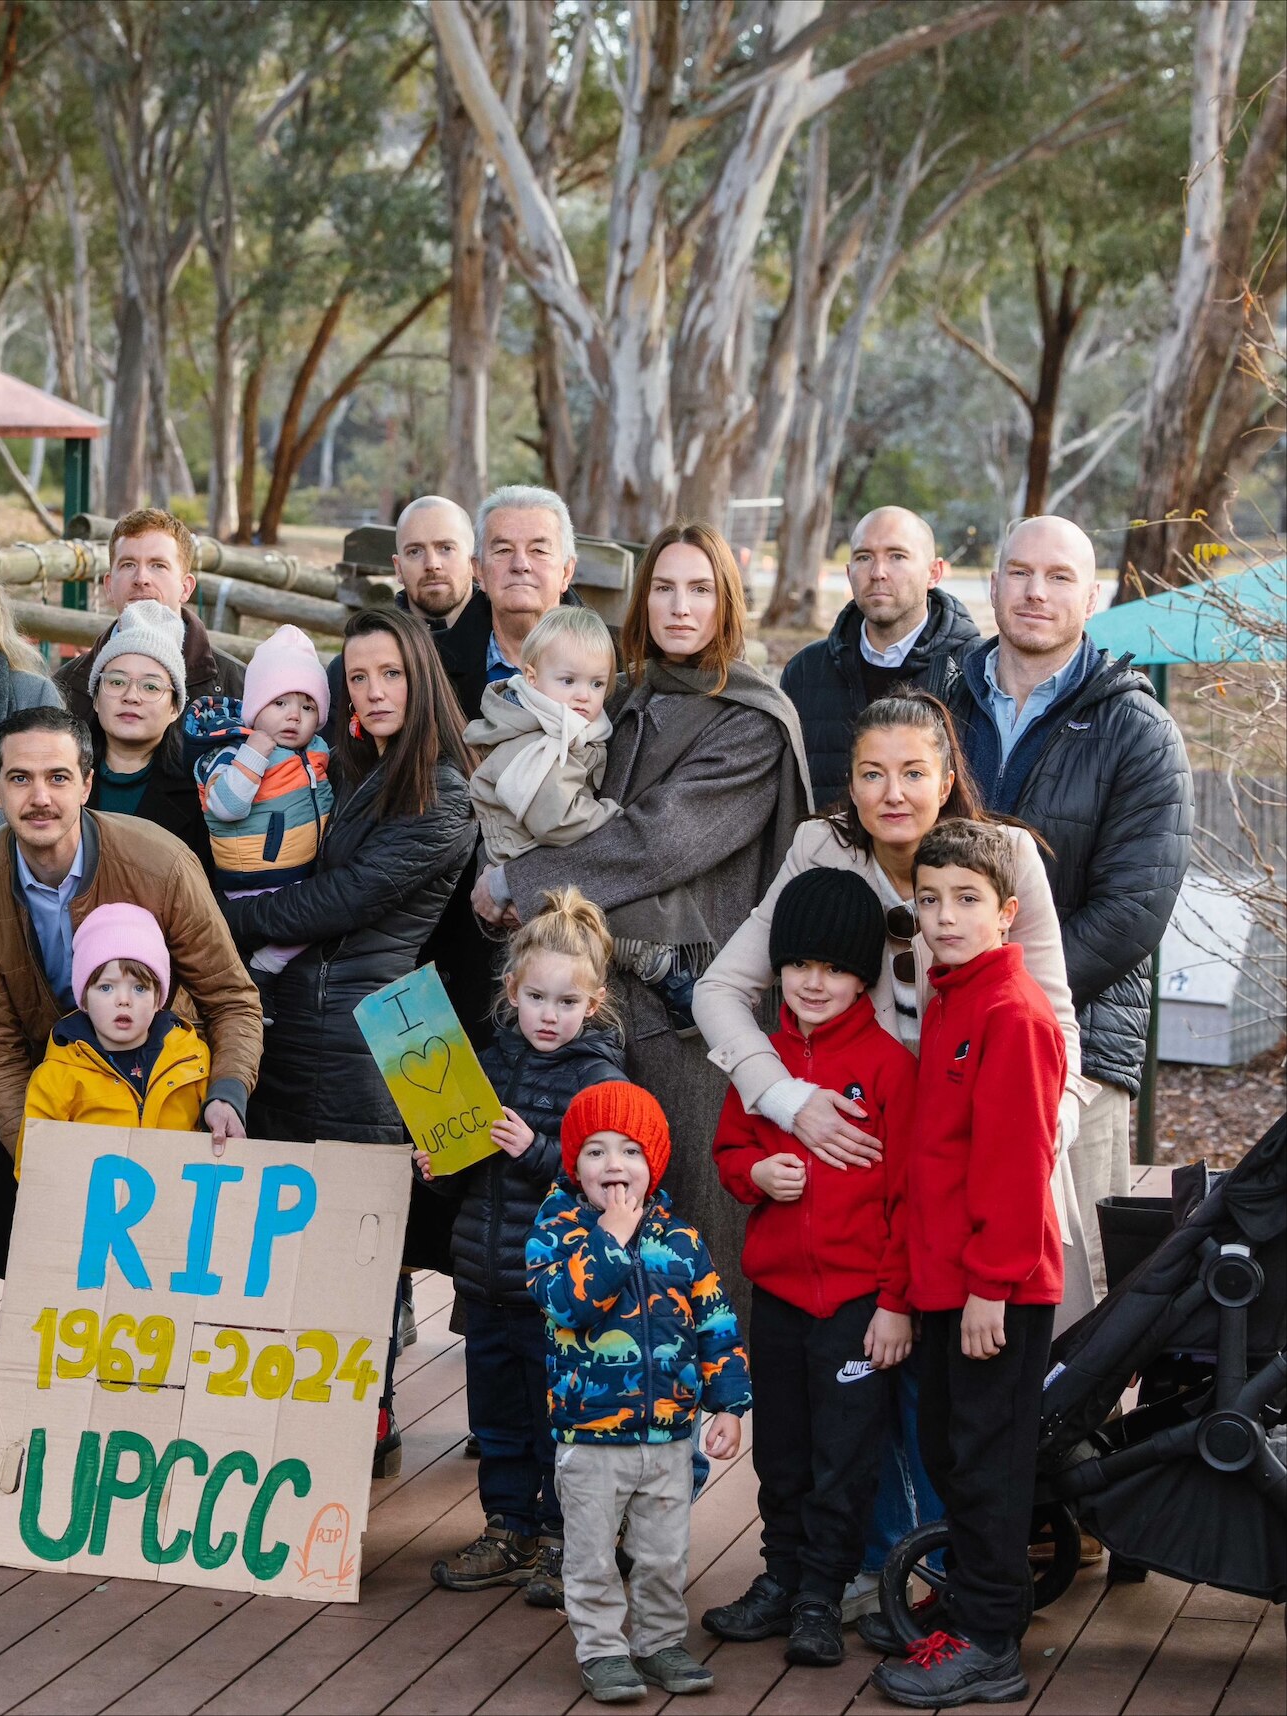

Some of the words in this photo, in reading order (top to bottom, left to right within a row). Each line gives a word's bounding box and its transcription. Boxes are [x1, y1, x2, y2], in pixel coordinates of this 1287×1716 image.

[382, 987, 424, 1036] I
[77, 1153, 318, 1297] RIP
[843, 1361, 872, 1375] NIKE
[19, 1427, 312, 1581] UPCCC
[315, 1527, 342, 1543] RIP
